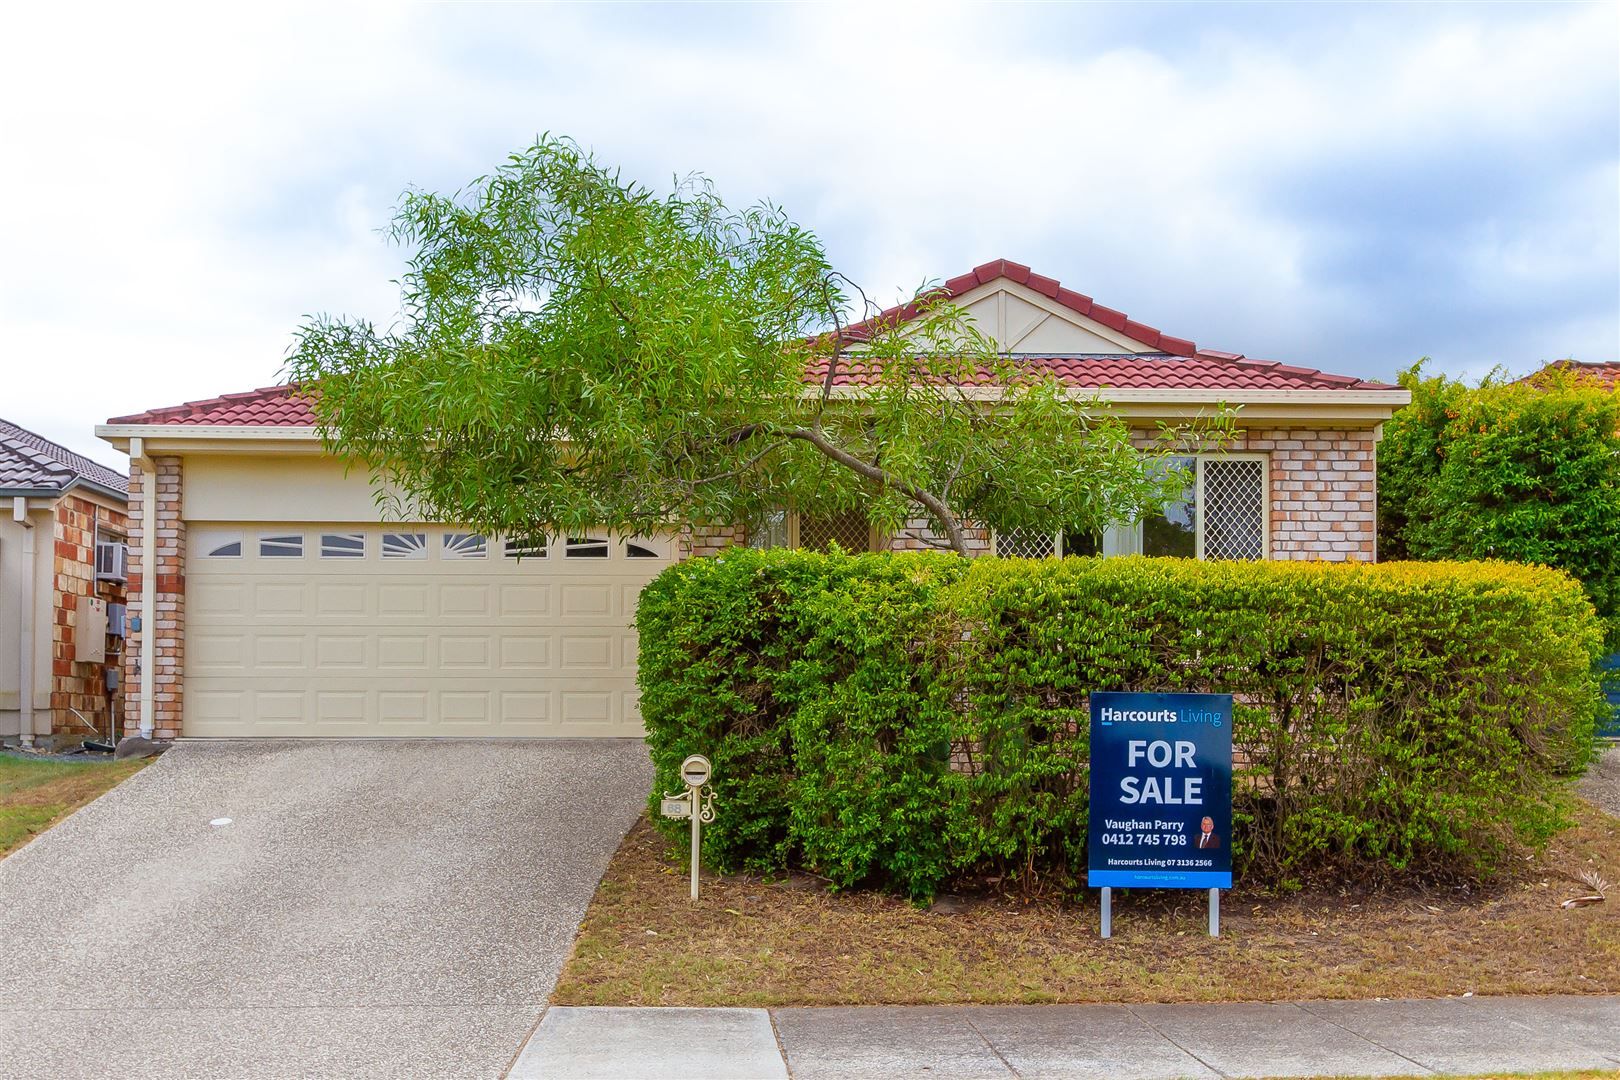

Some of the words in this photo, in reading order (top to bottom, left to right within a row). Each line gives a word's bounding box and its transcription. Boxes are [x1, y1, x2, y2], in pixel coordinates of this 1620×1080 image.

[1101, 707, 1177, 723] Harcourts
[1180, 709, 1222, 727] Living
[1128, 740, 1197, 768] FOR
[1119, 776, 1203, 805] SALE
[1105, 819, 1152, 831] Vaughan
[1154, 819, 1184, 832] Parry
[1102, 833, 1134, 846] 0412
[1136, 833, 1161, 846] 745
[1163, 834, 1187, 846] 798
[1108, 858, 1143, 866] Harcourts
[1144, 858, 1166, 867] Living
[1166, 859, 1176, 867] 07
[1176, 859, 1194, 867] 3136
[1194, 859, 1212, 867] 2566
